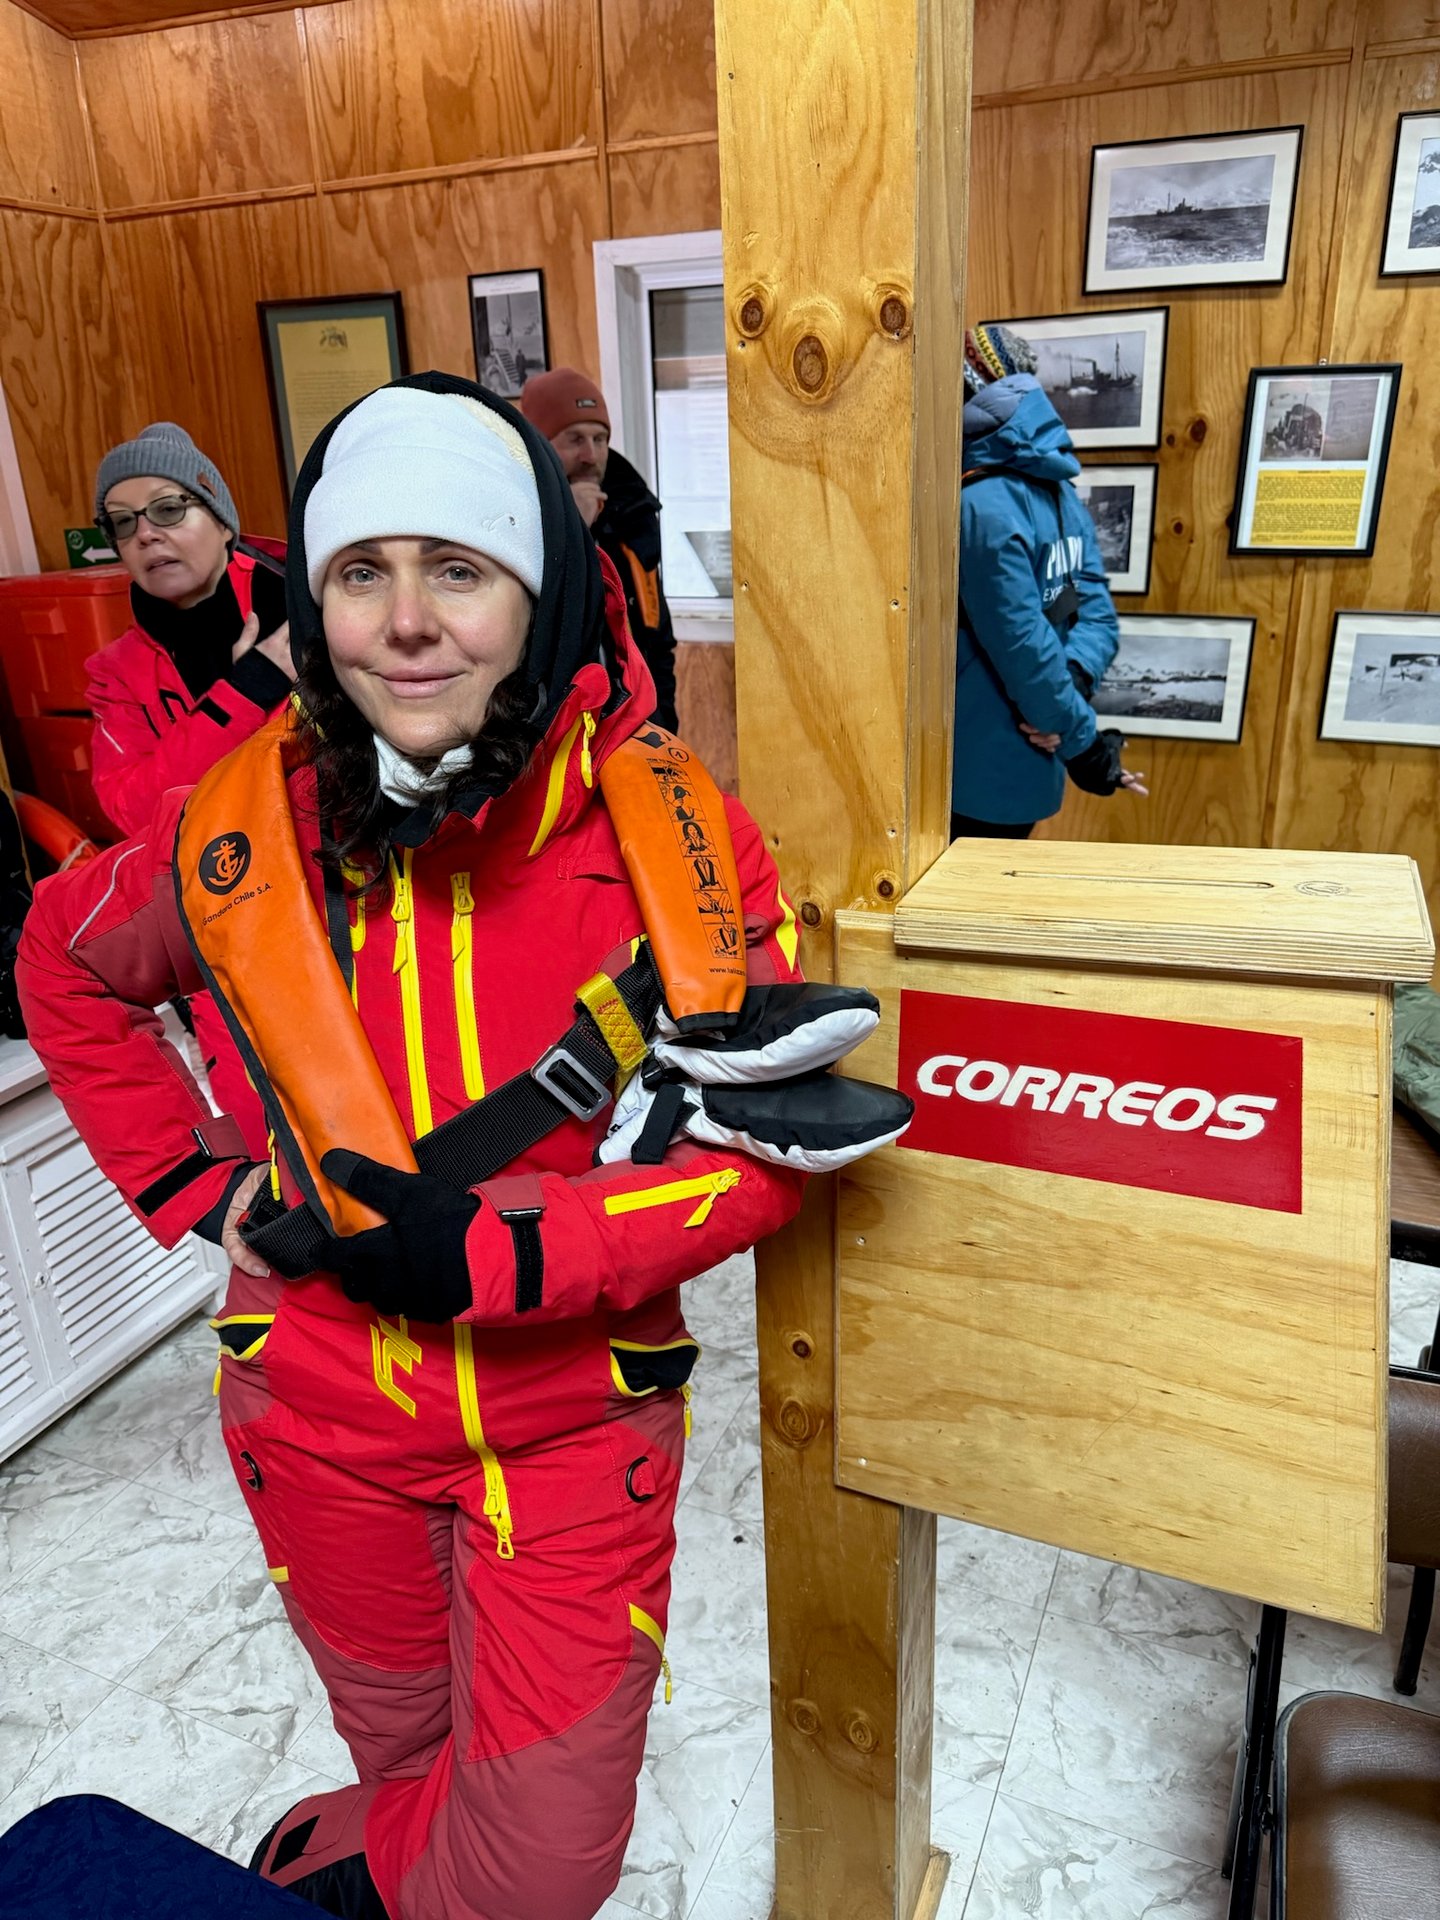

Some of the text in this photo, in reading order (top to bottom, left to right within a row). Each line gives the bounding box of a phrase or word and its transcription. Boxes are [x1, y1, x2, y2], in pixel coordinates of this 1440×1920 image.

[201, 882, 274, 926] Gandara Chile S.A.
[916, 1054, 1278, 1141] CORREOS
